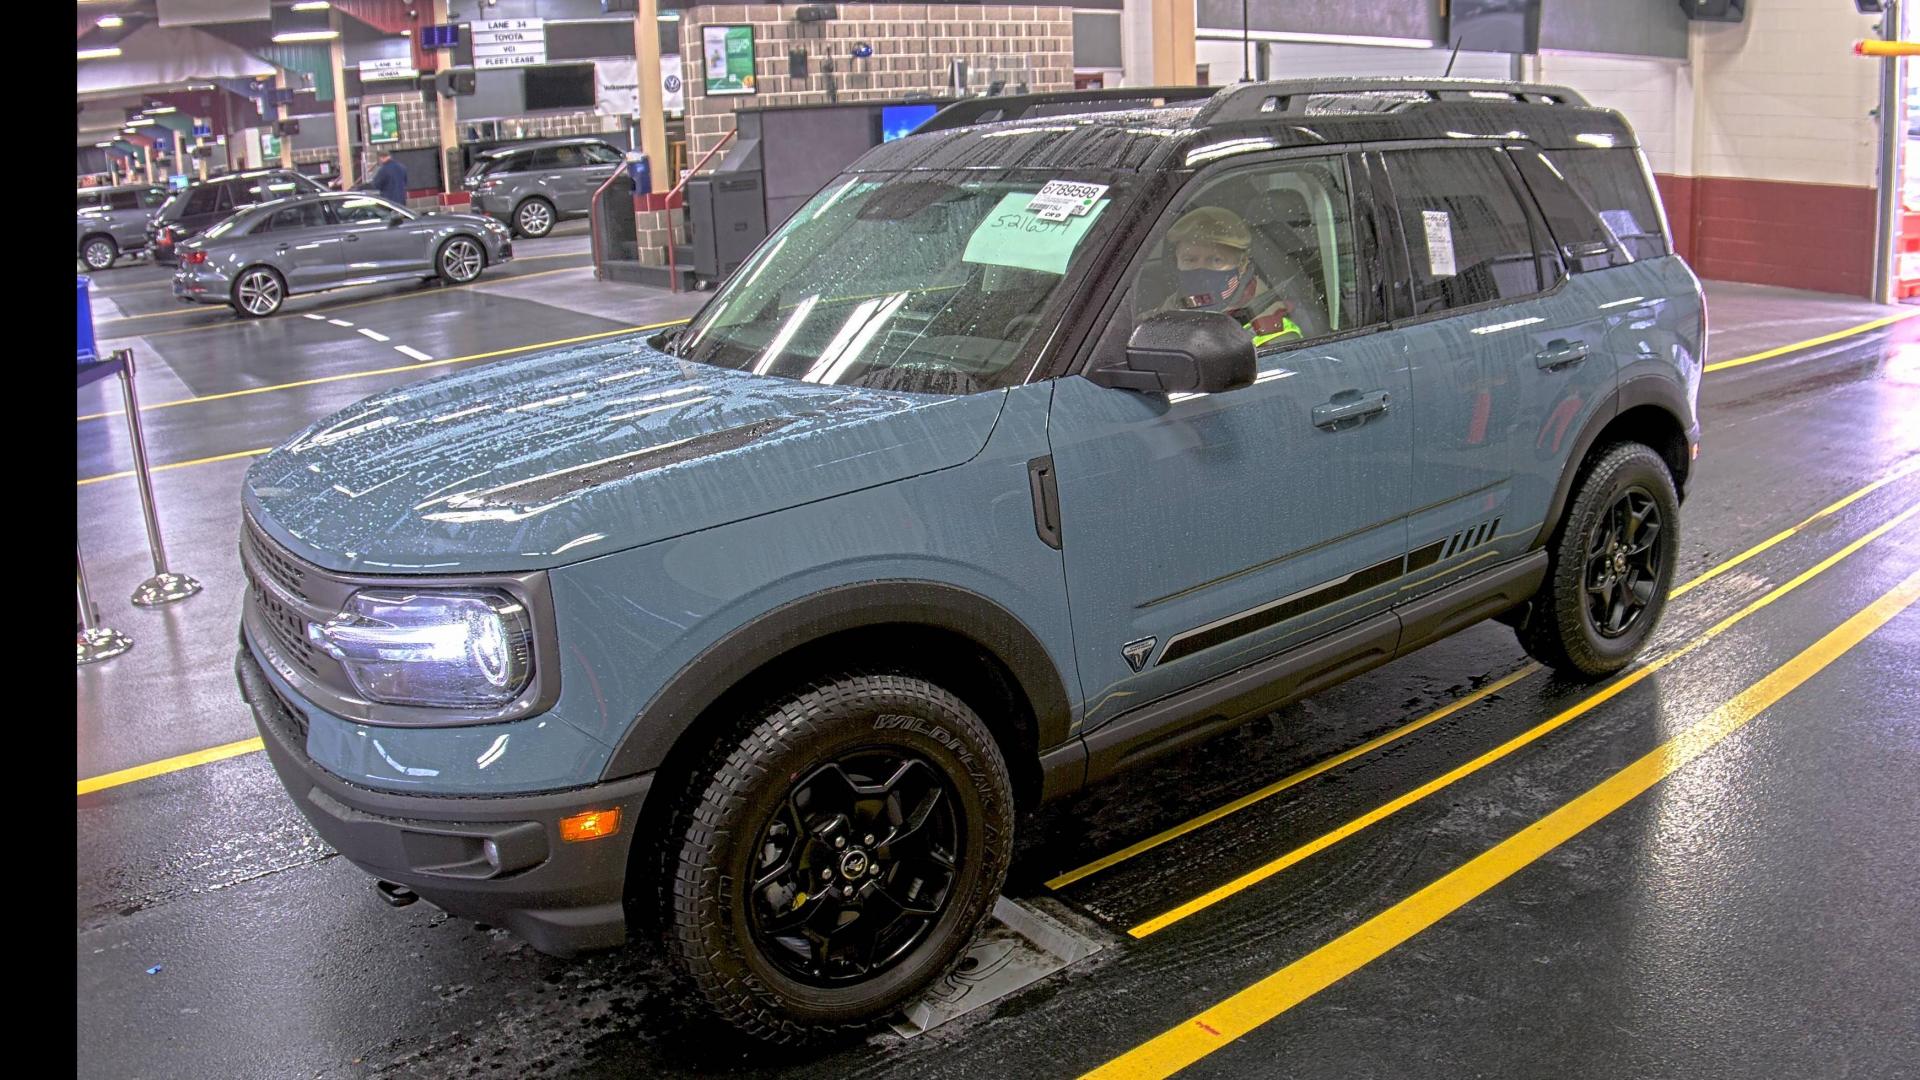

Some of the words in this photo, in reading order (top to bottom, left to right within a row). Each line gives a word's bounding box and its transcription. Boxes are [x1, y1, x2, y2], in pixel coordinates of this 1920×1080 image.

[488, 21, 509, 29] LANE
[494, 33, 523, 41] TOYOTA
[485, 57, 508, 65] FLEET
[511, 56, 534, 64] LEASE
[1042, 183, 1099, 199] 6789598
